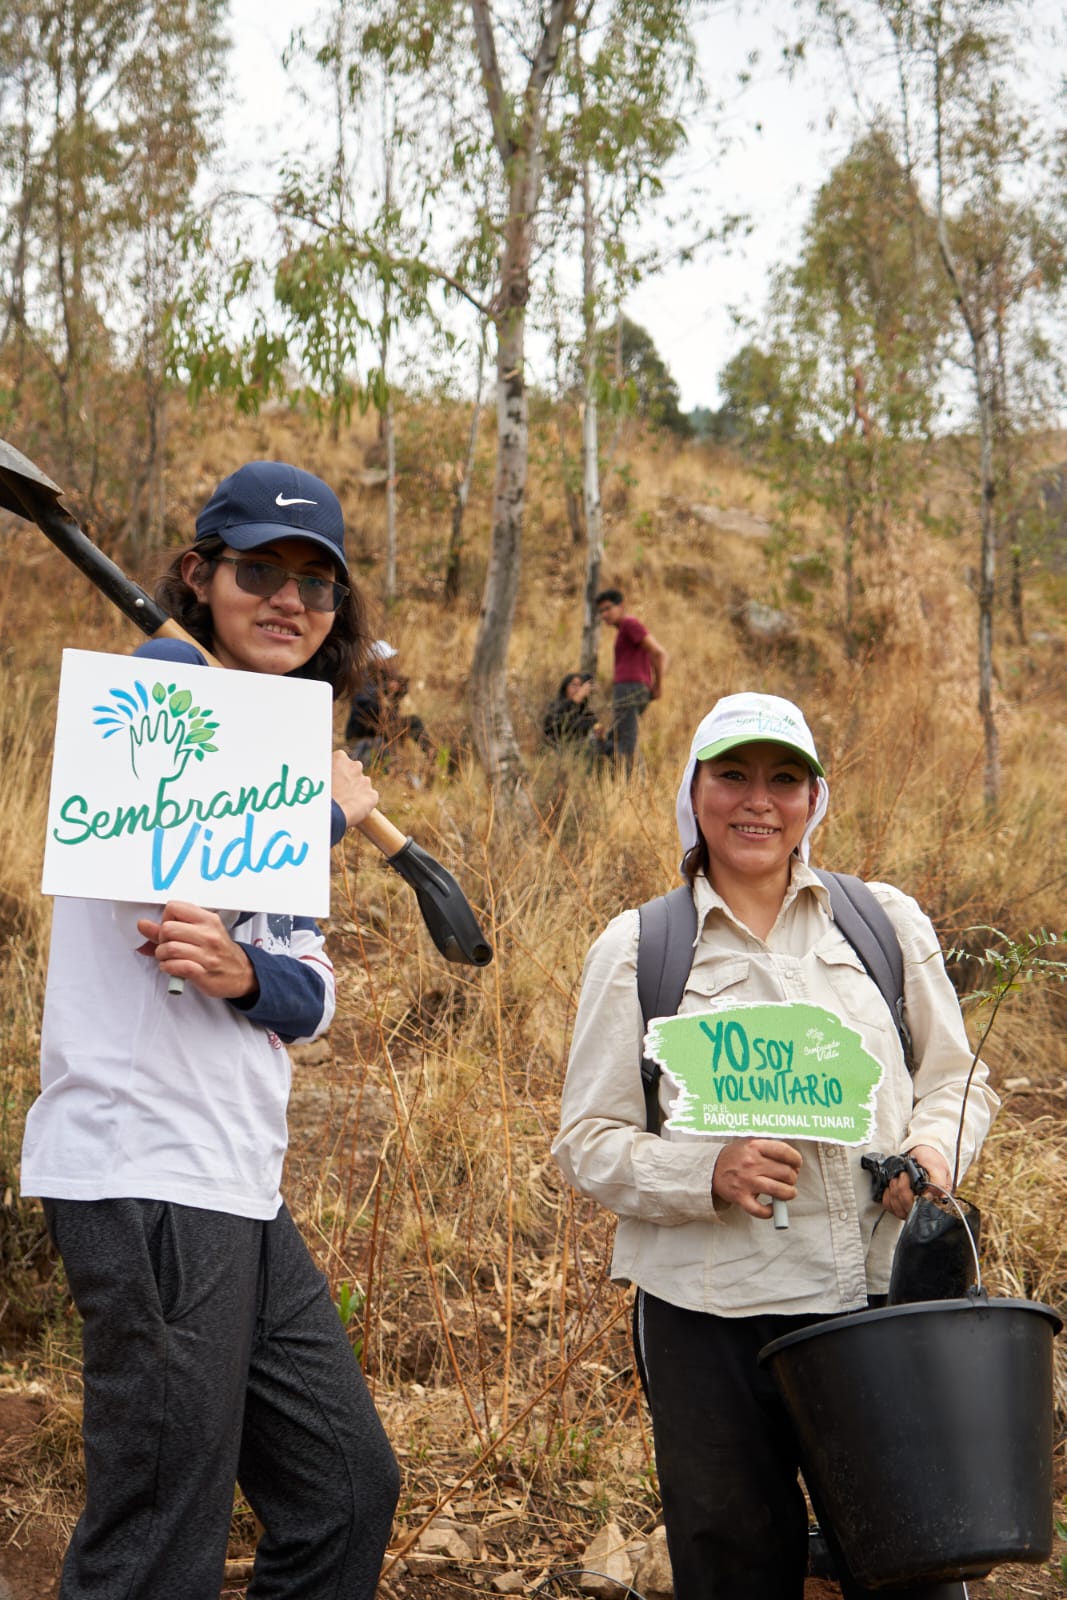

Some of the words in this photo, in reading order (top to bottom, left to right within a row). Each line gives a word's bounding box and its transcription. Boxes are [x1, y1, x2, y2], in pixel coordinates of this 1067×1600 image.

[53, 763, 325, 845] Sembrando
[151, 812, 309, 891] Vida
[699, 1020, 749, 1073] YO
[752, 1037, 794, 1072] SOY
[703, 1103, 717, 1113] POR
[719, 1104, 729, 1113] EL
[703, 1112, 749, 1128] PARQUE
[752, 1113, 811, 1128] NACIONAL
[812, 1115, 855, 1129] TUNARI
